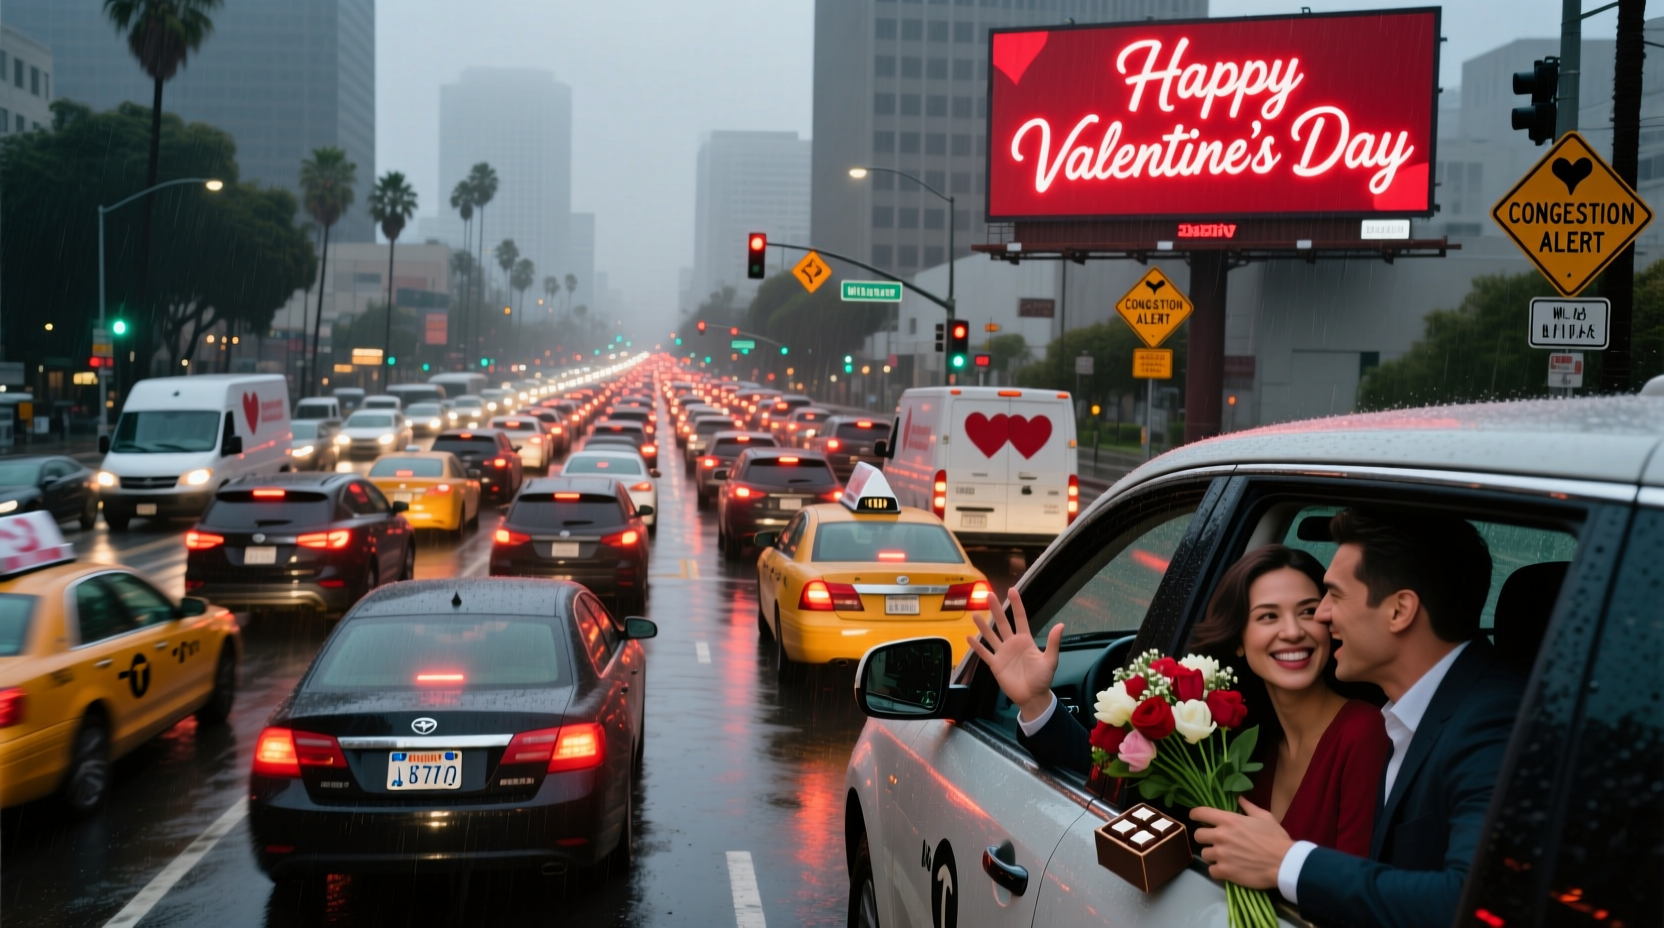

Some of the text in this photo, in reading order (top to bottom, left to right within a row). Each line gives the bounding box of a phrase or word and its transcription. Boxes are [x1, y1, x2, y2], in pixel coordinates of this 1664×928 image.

[1116, 37, 1304, 119] Happy
[1011, 105, 1415, 195] Valentine's Day
[1508, 202, 1635, 225] CONGESTION
[1539, 231, 1605, 253] ALERT
